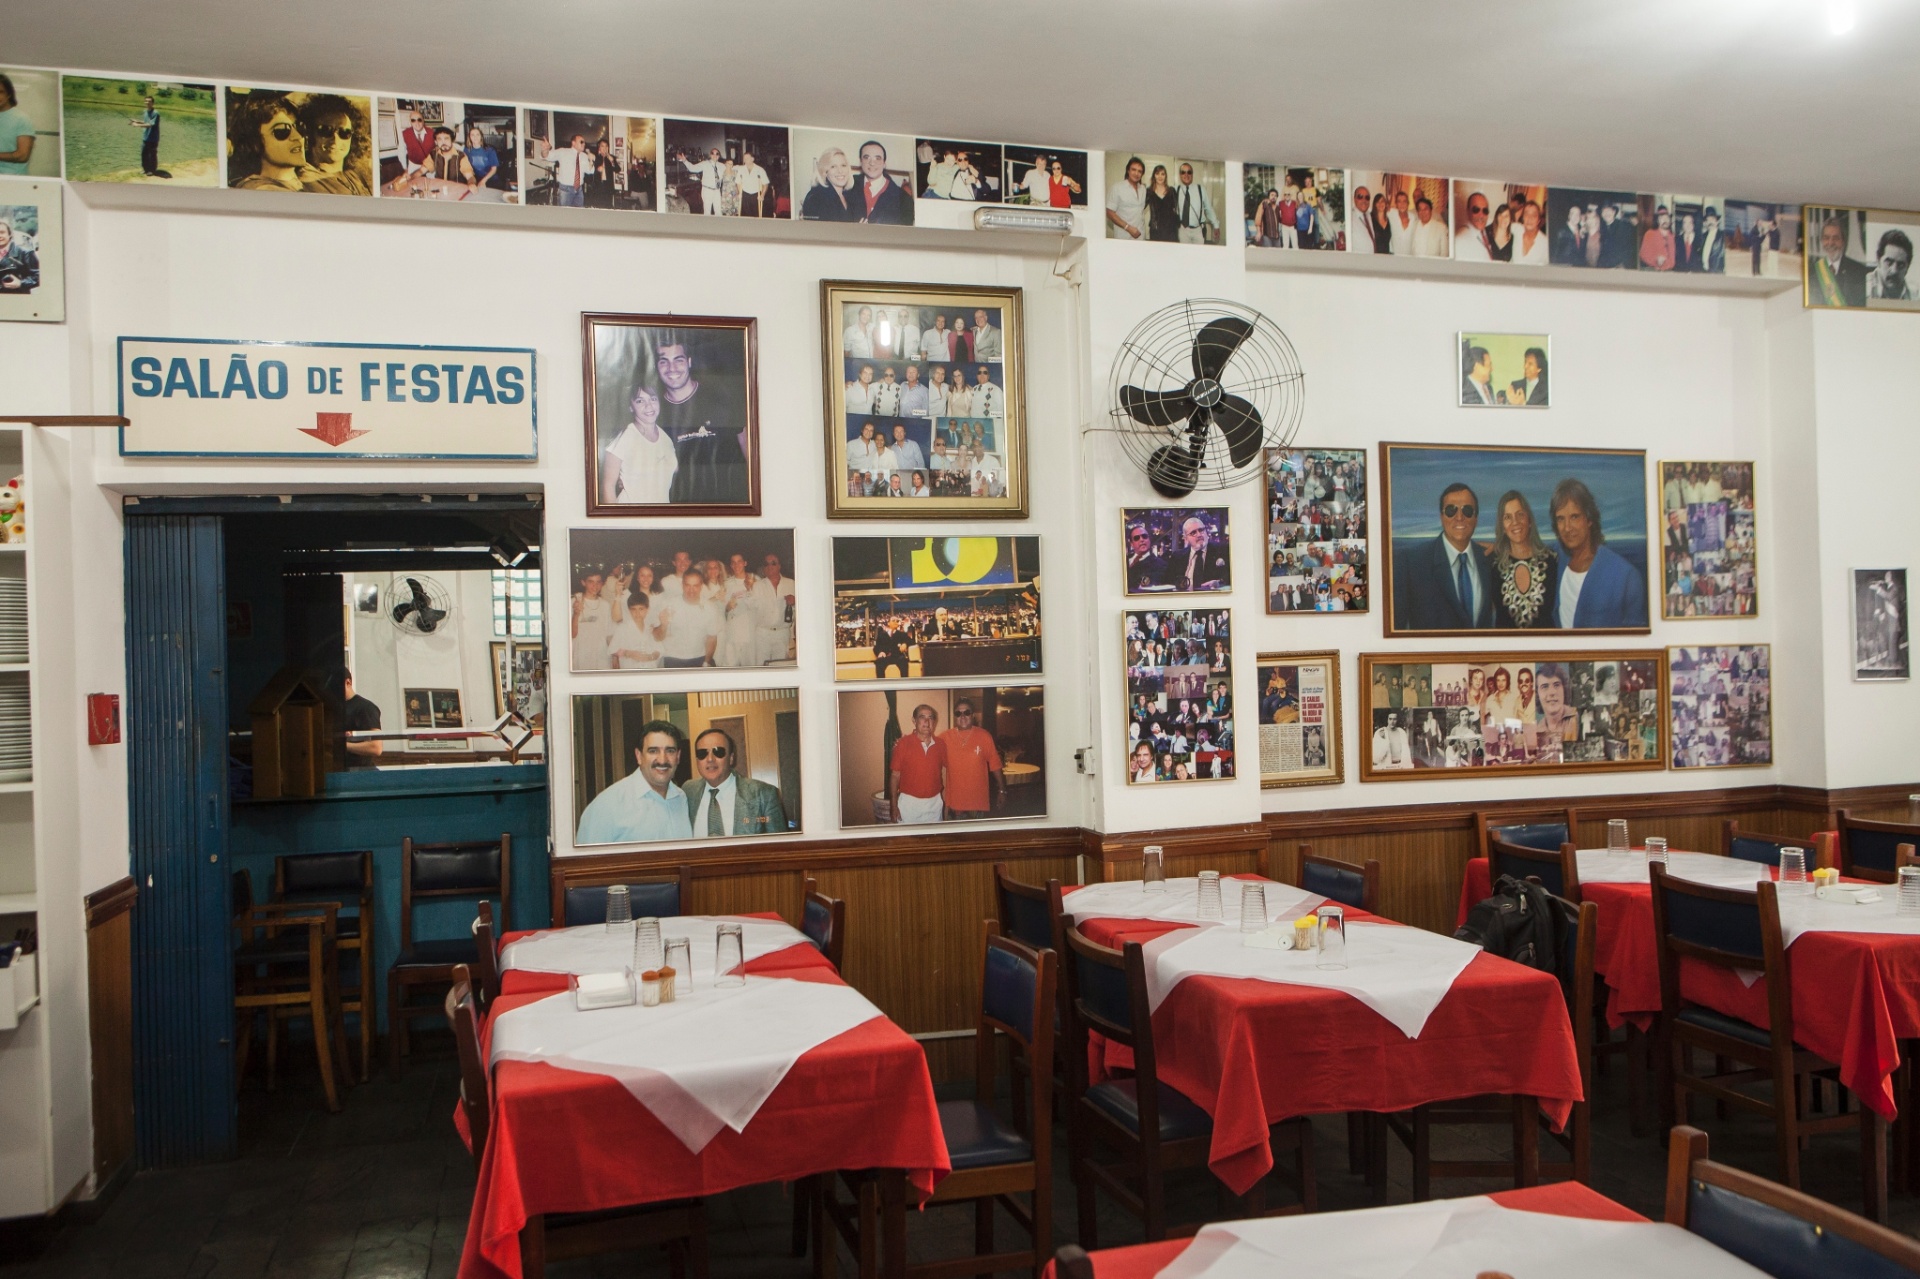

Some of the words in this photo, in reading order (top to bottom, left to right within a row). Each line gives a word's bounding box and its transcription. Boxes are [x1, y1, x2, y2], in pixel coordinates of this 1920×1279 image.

[131, 353, 289, 400] SALÃO
[307, 366, 343, 395] DE
[361, 362, 525, 405] FESTAS
